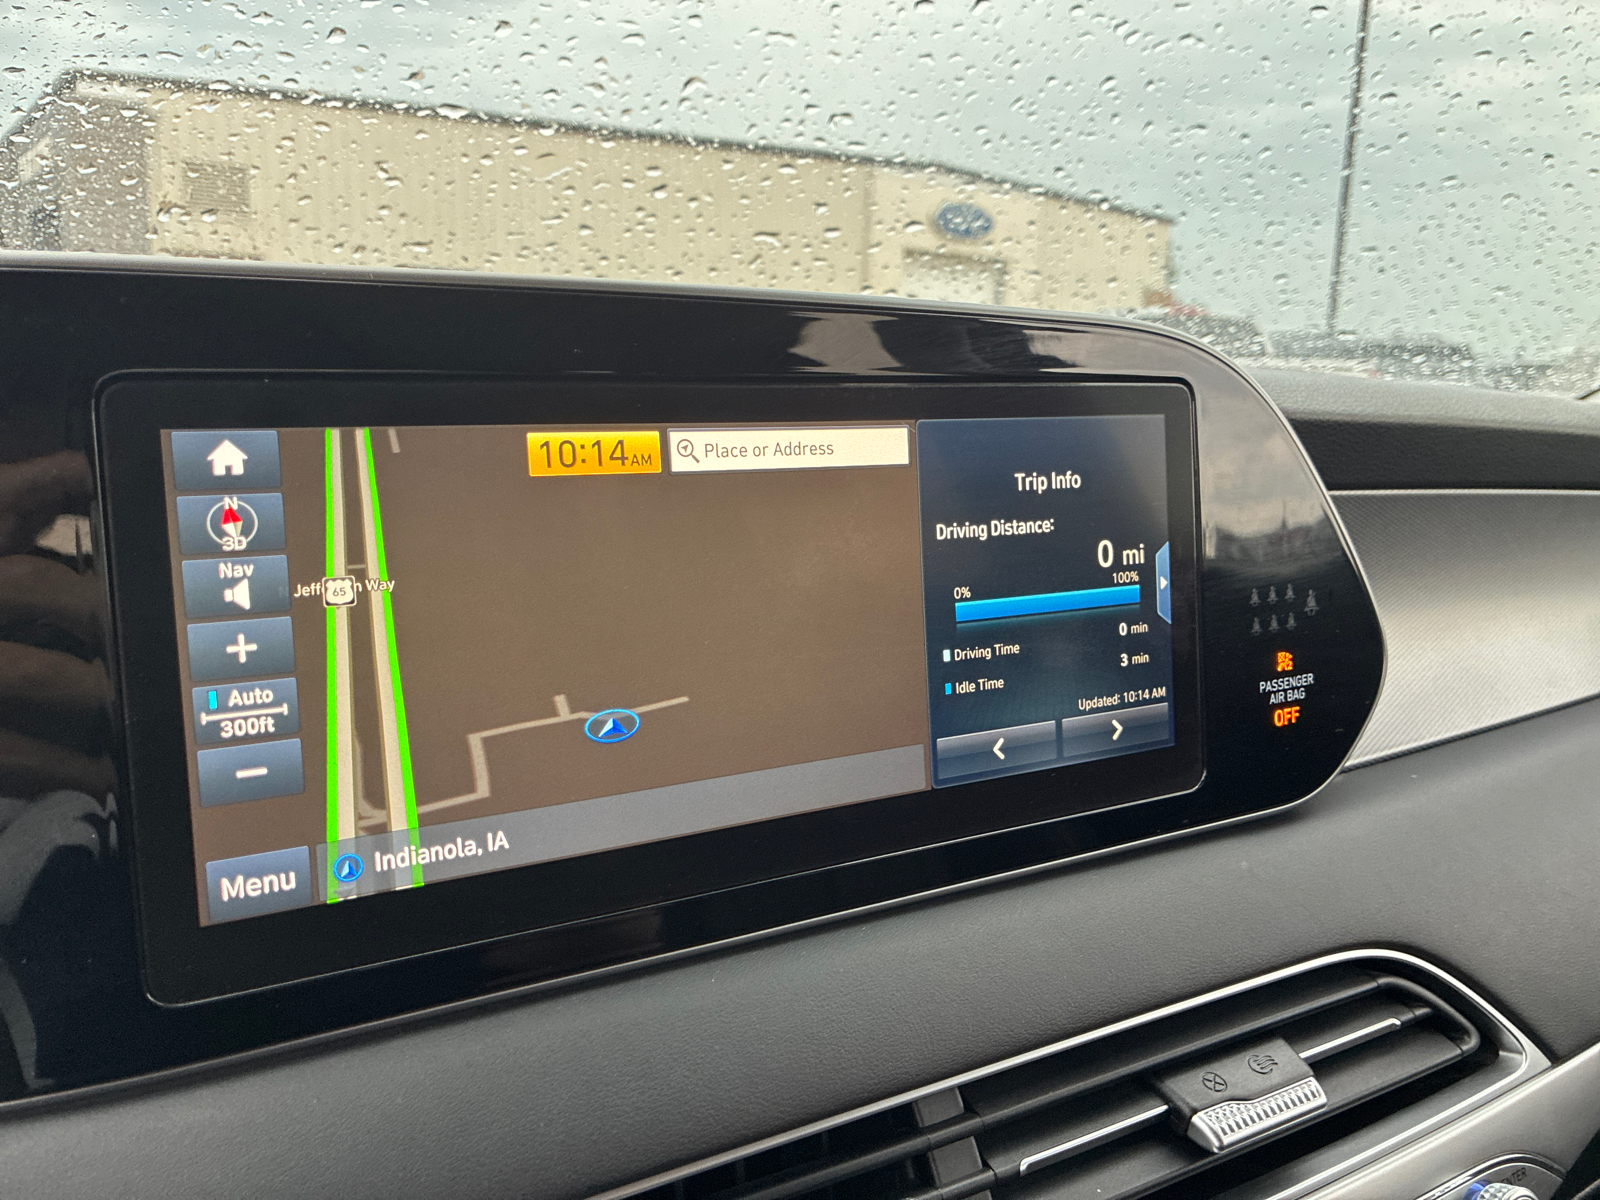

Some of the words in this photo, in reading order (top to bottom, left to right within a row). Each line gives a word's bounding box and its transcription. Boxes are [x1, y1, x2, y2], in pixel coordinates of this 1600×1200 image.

[539, 438, 629, 469] 10:14
[630, 453, 653, 467] AM
[704, 443, 748, 459] Place
[752, 447, 769, 457] or
[773, 441, 834, 456] Address
[1014, 472, 1048, 494] Trip
[1051, 471, 1081, 490] Info
[223, 496, 239, 510] N
[936, 520, 988, 540] Driving
[990, 518, 1055, 537] Distance:
[222, 536, 247, 551] 3D
[1097, 539, 1114, 568] 0
[1122, 543, 1145, 565] mi
[218, 562, 254, 579] Nav
[1112, 571, 1139, 584] 100%
[332, 587, 346, 597] 65
[365, 578, 395, 592] Way
[954, 587, 971, 600] 0%
[1118, 622, 1128, 636] 0
[1130, 622, 1148, 634] min
[954, 646, 992, 661] Driving
[994, 643, 1020, 656] Time
[1120, 653, 1129, 667] 3
[1131, 653, 1150, 665] min
[955, 681, 976, 695] Idle
[978, 677, 1005, 691] Time
[1260, 673, 1314, 693] PASSENGER
[227, 689, 275, 707] Auto
[1078, 694, 1121, 711] Updated:
[1123, 690, 1150, 704] 10:14
[1151, 686, 1167, 699] AM
[1269, 692, 1286, 705] AIR
[1287, 687, 1306, 702] BAG
[1274, 706, 1300, 726] OFF
[219, 717, 276, 739] 300ft
[374, 837, 483, 873] Indianola,
[487, 830, 510, 851] IA
[220, 870, 297, 902] Menu
